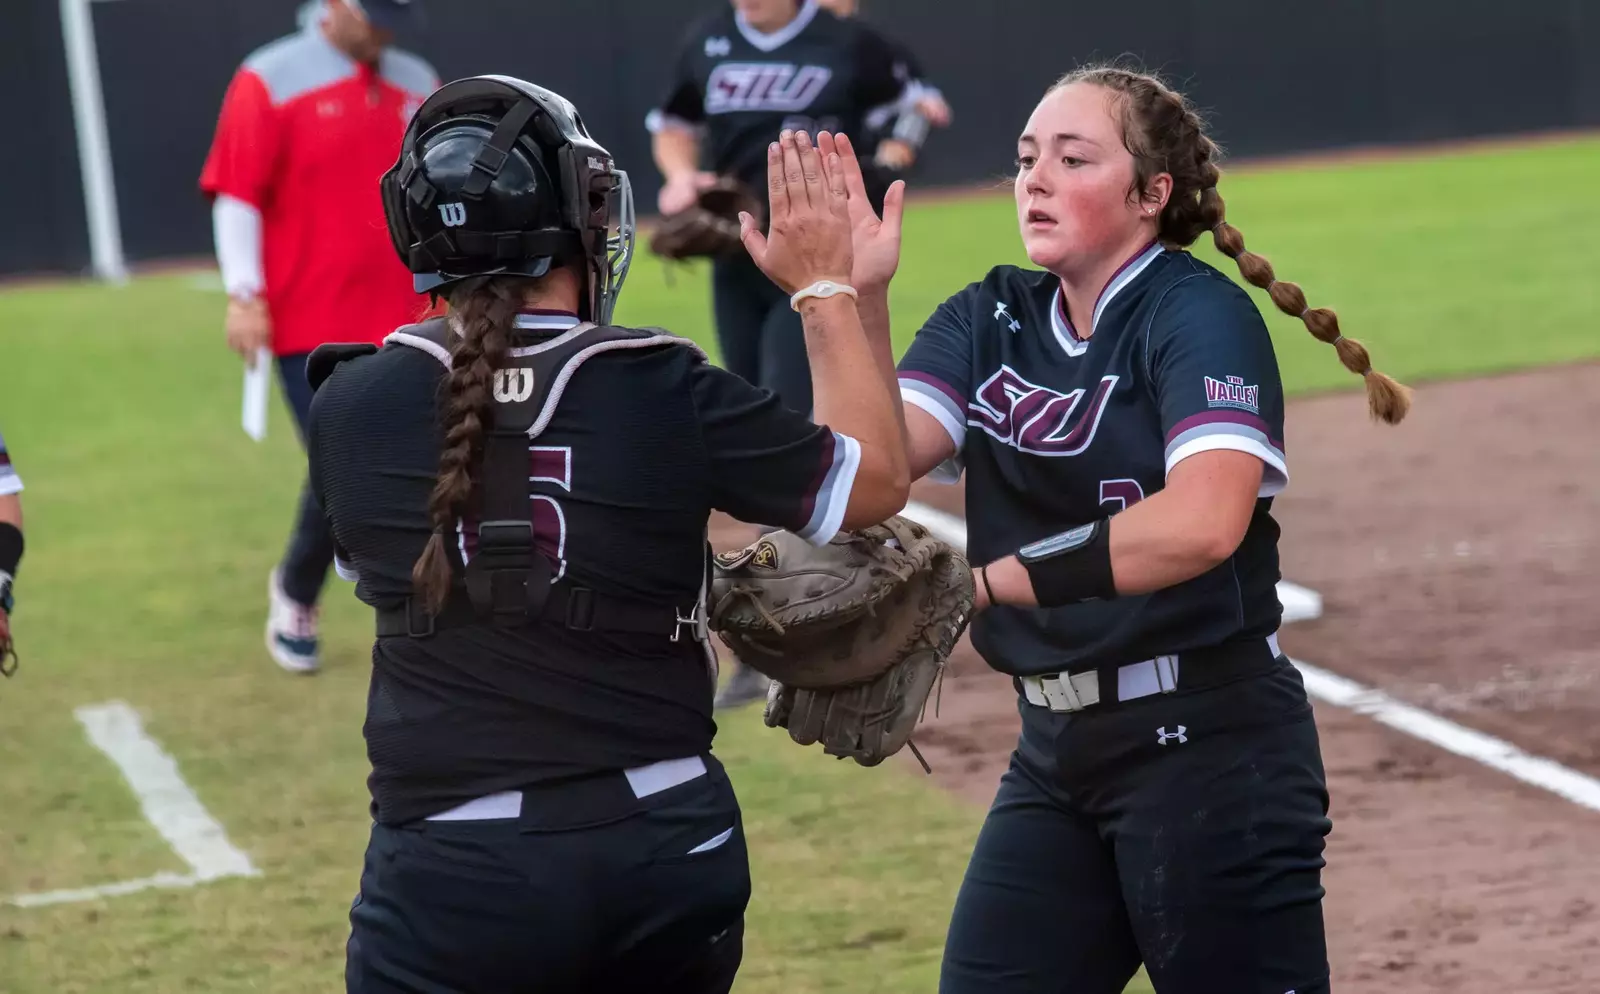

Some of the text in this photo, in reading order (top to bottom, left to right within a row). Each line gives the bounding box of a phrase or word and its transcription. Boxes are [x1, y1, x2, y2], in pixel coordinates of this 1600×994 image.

[704, 63, 831, 114] SIU
[1204, 376, 1258, 408] VALLEY
[1226, 375, 1243, 385] THE
